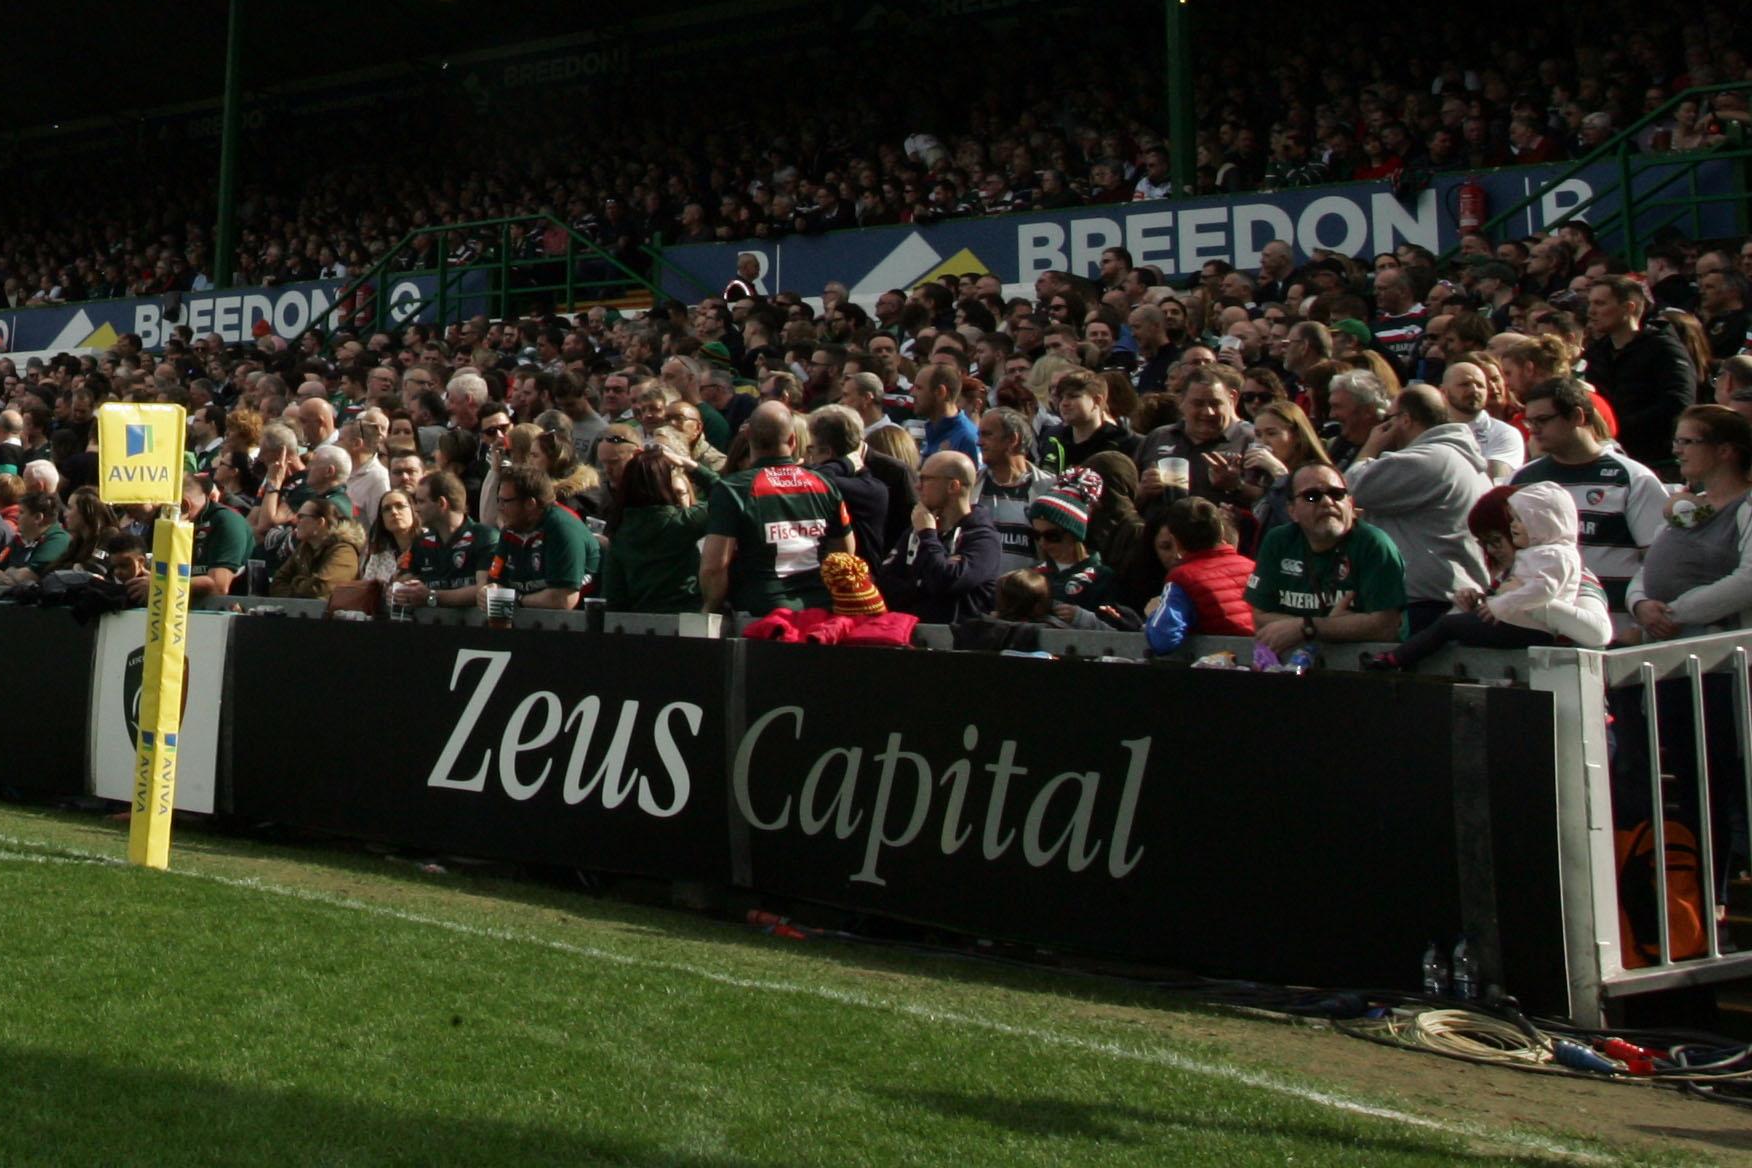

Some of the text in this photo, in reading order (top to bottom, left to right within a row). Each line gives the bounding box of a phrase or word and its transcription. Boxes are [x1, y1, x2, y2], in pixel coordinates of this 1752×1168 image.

[1018, 188, 1439, 284] BREEDON
[134, 288, 340, 353] BREEDON
[390, 281, 422, 322] Q
[108, 465, 169, 482] AVIVA
[150, 586, 164, 644] AVIVA
[172, 586, 186, 646] AVIVA
[136, 757, 152, 814] AVIVA
[158, 757, 173, 816] AVIVA
[428, 648, 1152, 886] Zeus Capital
